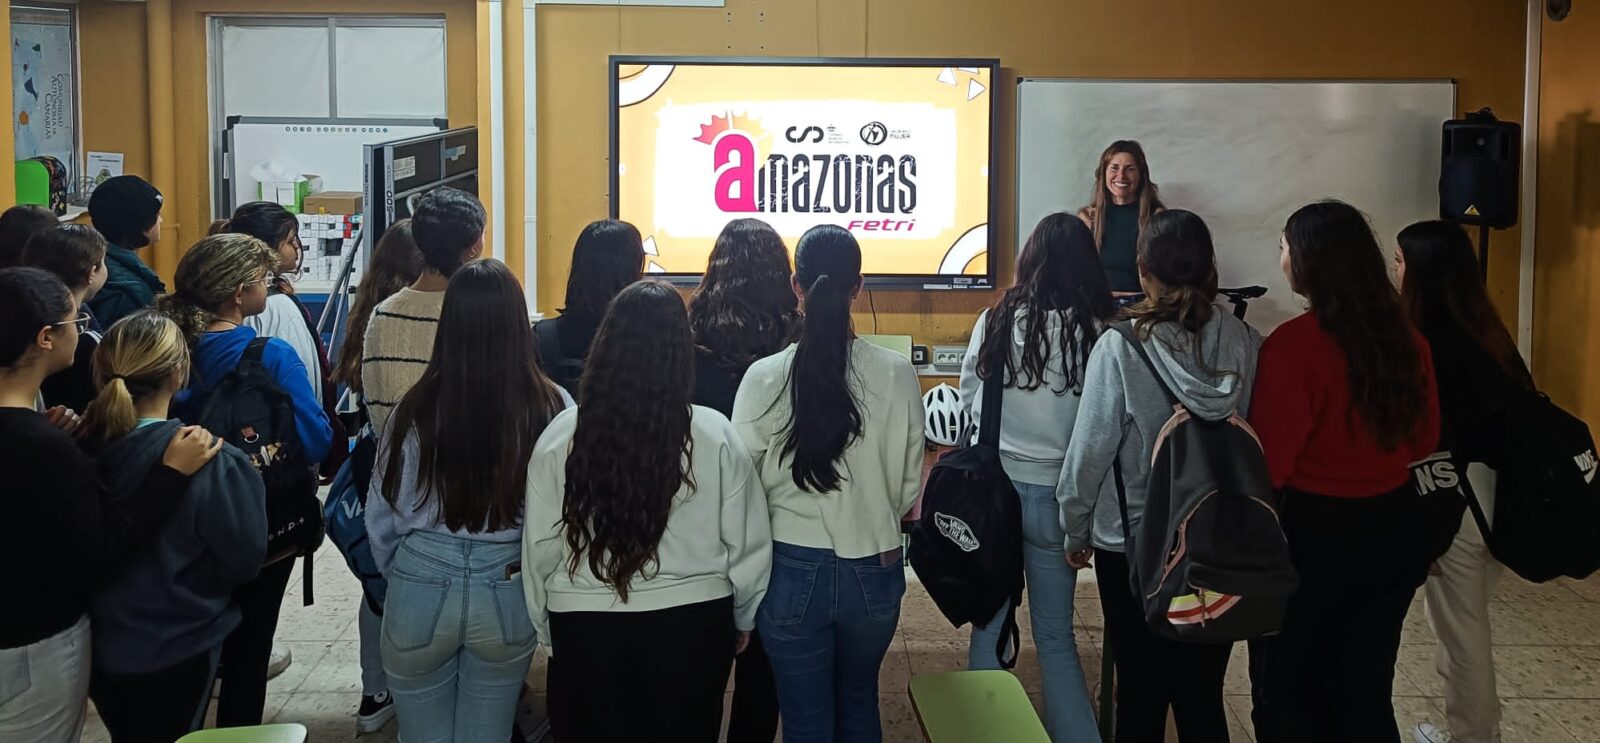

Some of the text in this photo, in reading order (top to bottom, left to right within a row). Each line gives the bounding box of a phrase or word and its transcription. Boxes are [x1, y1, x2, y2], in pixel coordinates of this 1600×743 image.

[45, 93, 53, 139] CANARIAS
[714, 133, 917, 214] amazonas
[1413, 460, 1459, 496] NS
